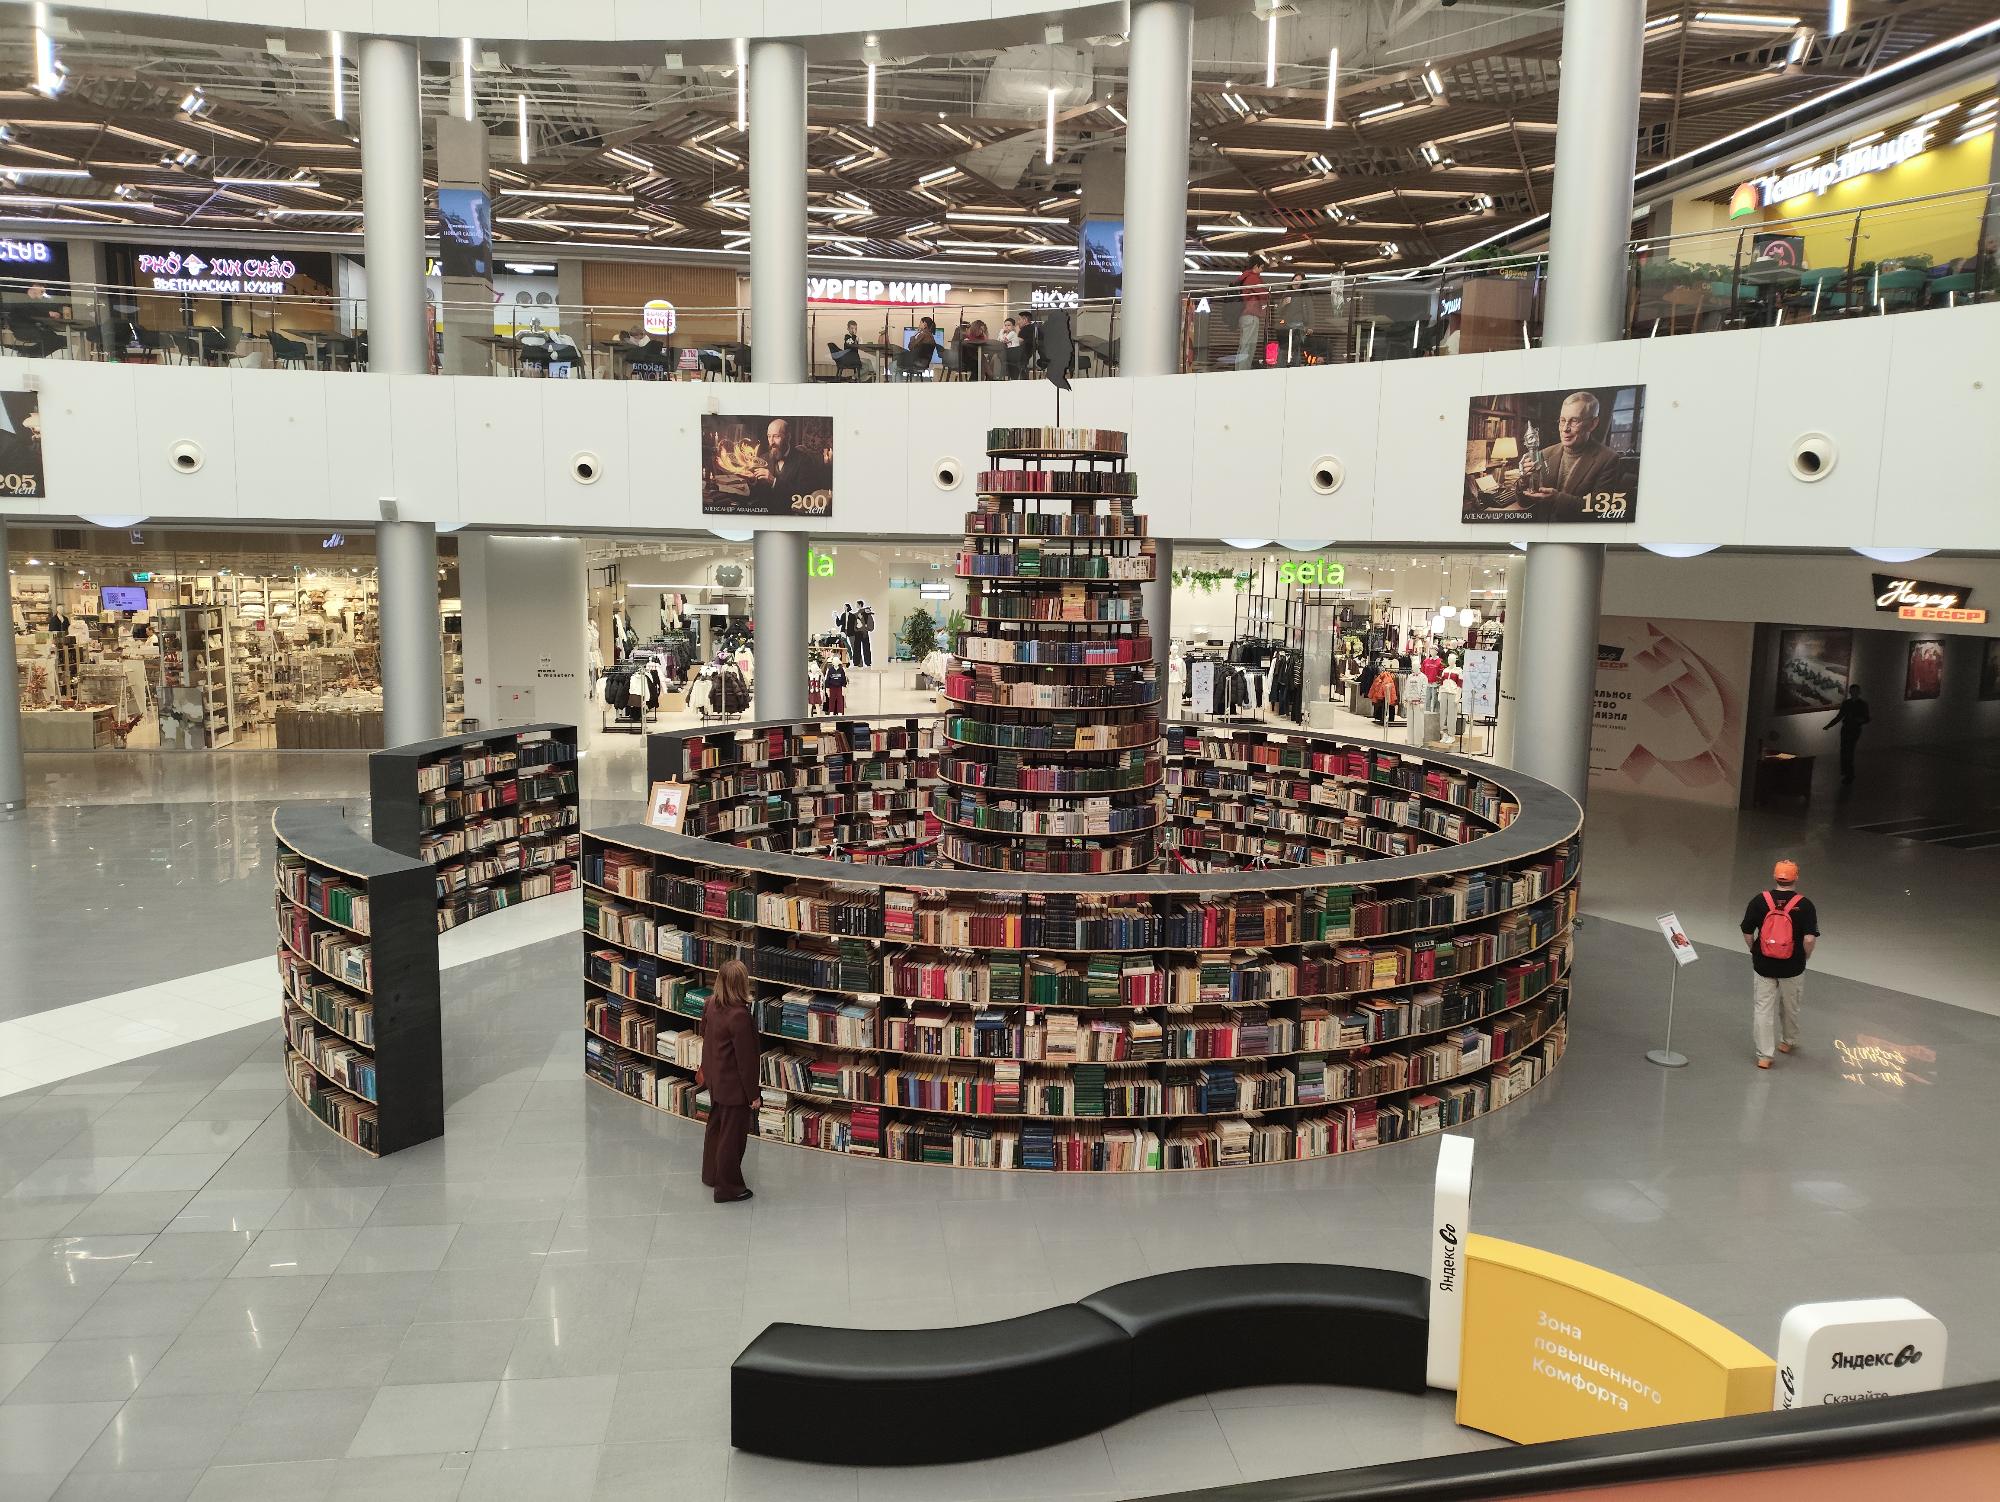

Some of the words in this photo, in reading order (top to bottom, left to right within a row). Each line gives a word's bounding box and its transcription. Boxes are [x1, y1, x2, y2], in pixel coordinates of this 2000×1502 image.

[209, 258, 242, 277] XIN
[153, 277, 240, 293] ВЬЕТНАМСКАЯ
[243, 280, 284, 294] КУХНЯ
[888, 281, 952, 304] КИНГ
[645, 317, 674, 328] KING
[791, 494, 827, 510] 200
[1582, 492, 1627, 513] 135
[1597, 508, 1626, 519] лет
[1463, 512, 1502, 520] АЛЕКСАНДР
[808, 549, 834, 577] la
[1279, 556, 1345, 585] sela
[1922, 610, 1981, 620] СССР
[1439, 1223, 1458, 1246] Go
[1439, 1245, 1457, 1293] Яндекс
[1536, 1309, 1583, 1341] Зона
[1831, 1351, 1894, 1371] Яндекс
[1894, 1344, 1924, 1368] Go
[1534, 1335, 1663, 1405] повышенного
[1532, 1356, 1630, 1412] Комфорта
